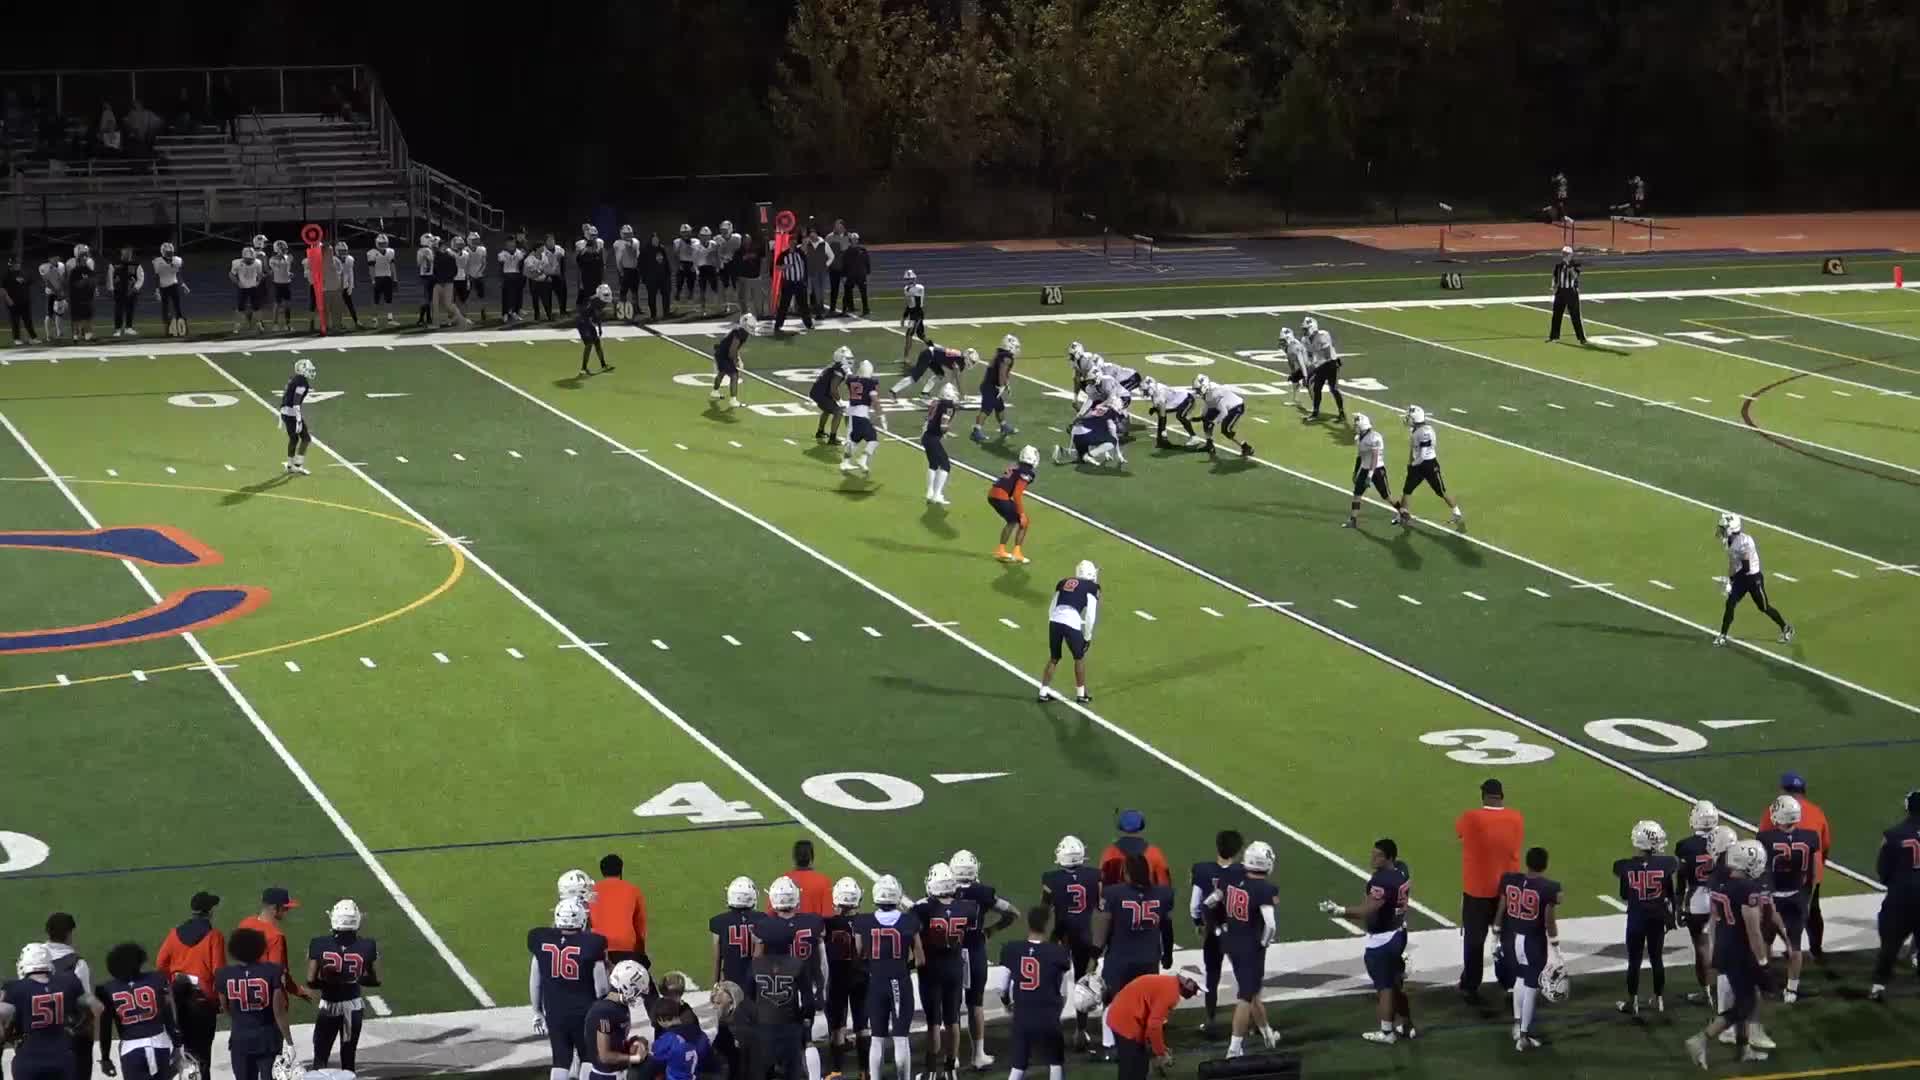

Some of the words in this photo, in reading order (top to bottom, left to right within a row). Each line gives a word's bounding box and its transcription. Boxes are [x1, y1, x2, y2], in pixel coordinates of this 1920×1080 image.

[1446, 273, 1461, 288] 10
[1829, 259, 1843, 274] G
[616, 302, 633, 319] 30
[1046, 286, 1062, 304] 20
[168, 318, 186, 336] 40
[1418, 717, 1708, 765] 30
[633, 770, 925, 824] 40
[1066, 883, 1087, 914] 3
[1627, 869, 1665, 900] 45
[1121, 899, 1160, 931] 75
[1226, 884, 1249, 922] 18
[1505, 884, 1540, 921] 89
[871, 927, 901, 960] 17
[322, 951, 364, 984] 23
[541, 943, 581, 980] 76
[1019, 956, 1041, 991] 9
[31, 991, 65, 1029] 51
[112, 985, 158, 1025] 29
[226, 977, 270, 1012] 43
